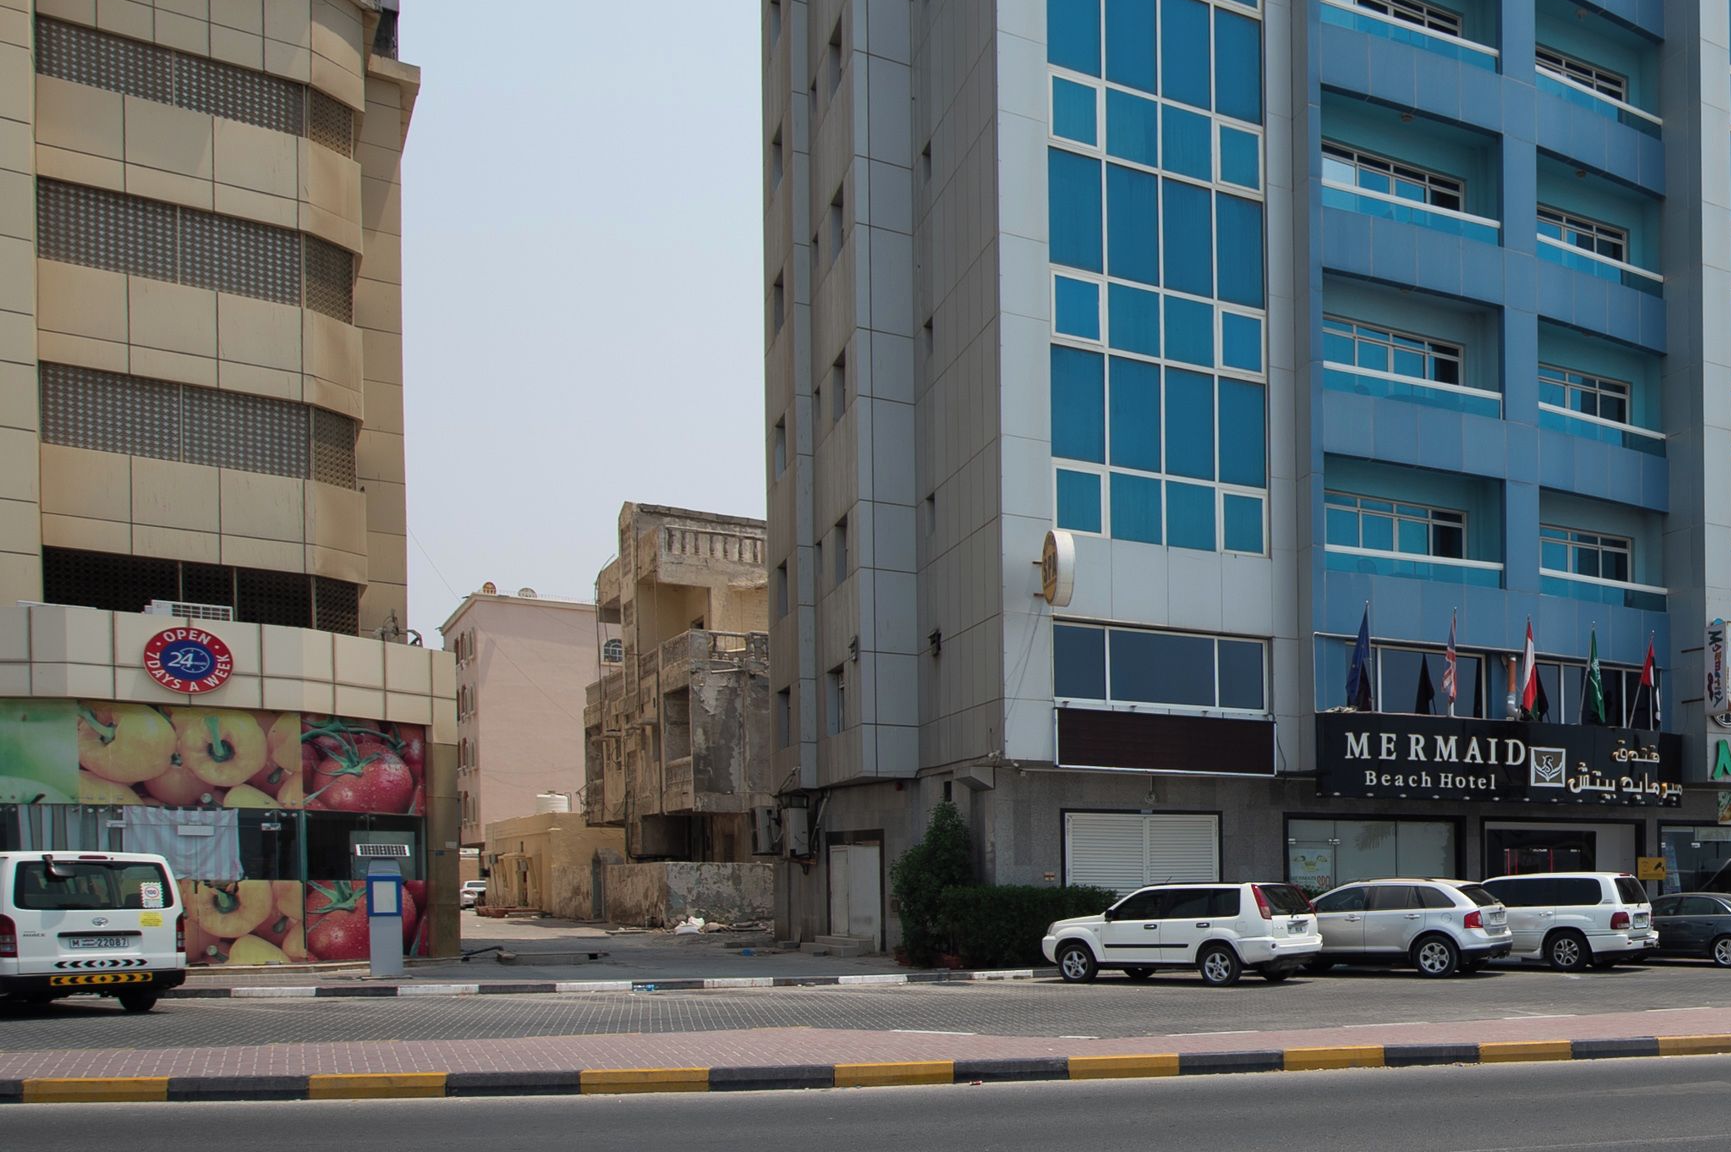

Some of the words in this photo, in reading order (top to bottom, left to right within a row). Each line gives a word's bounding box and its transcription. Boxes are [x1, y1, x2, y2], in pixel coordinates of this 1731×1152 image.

[162, 629, 212, 645] OPEN
[167, 651, 195, 668] 24
[189, 681, 200, 691] A
[203, 654, 231, 687] WEEK
[1344, 731, 1526, 766] MERMAID
[1612, 739, 1660, 763] فندق
[1364, 770, 1432, 787] Beach
[1440, 772, 1496, 790] Hotel
[1567, 762, 1616, 800] بيتش
[1620, 772, 1683, 801] ميرمايد
